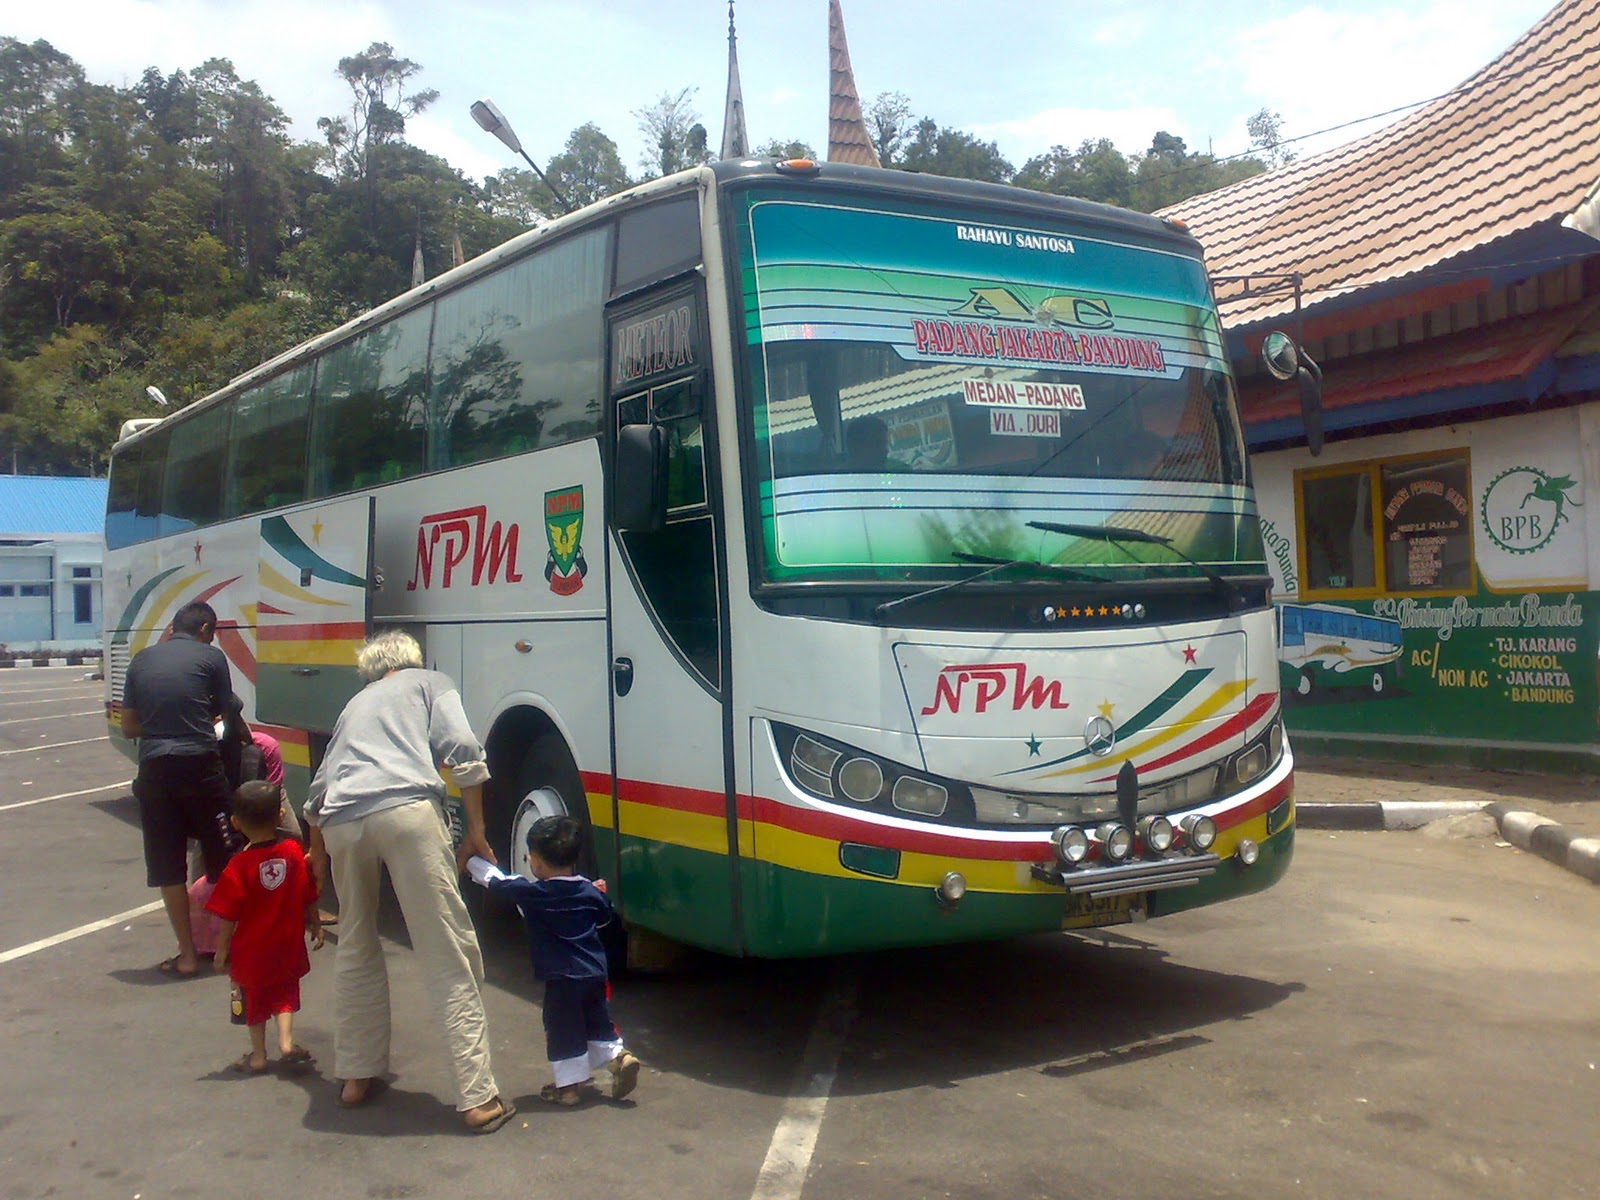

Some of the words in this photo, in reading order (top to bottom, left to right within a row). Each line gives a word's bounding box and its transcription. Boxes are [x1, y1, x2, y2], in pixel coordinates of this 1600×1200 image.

[956, 225, 1013, 247] RAHAYU
[1016, 234, 1076, 254] SANTOSA
[947, 287, 1115, 330] AC
[615, 306, 694, 385] METEOR
[911, 319, 995, 357] PADANG
[997, 326, 1080, 365] JAKARTA
[1080, 334, 1167, 373] BANDUNG
[1027, 413, 1060, 435] DURI
[546, 490, 582, 515] NPM
[1501, 514, 1542, 542] BPB
[1273, 538, 1299, 593] Bunda
[1397, 597, 1453, 641] Bintang
[1451, 596, 1522, 628] Permata
[1520, 593, 1584, 628] Bunda
[1519, 638, 1577, 652] KARANG
[1498, 654, 1563, 670] CIKOKOL
[1438, 668, 1466, 687] NON
[1469, 670, 1489, 689] AC
[1505, 671, 1571, 687] JAKARTA
[1511, 689, 1575, 704] BANDUNG
